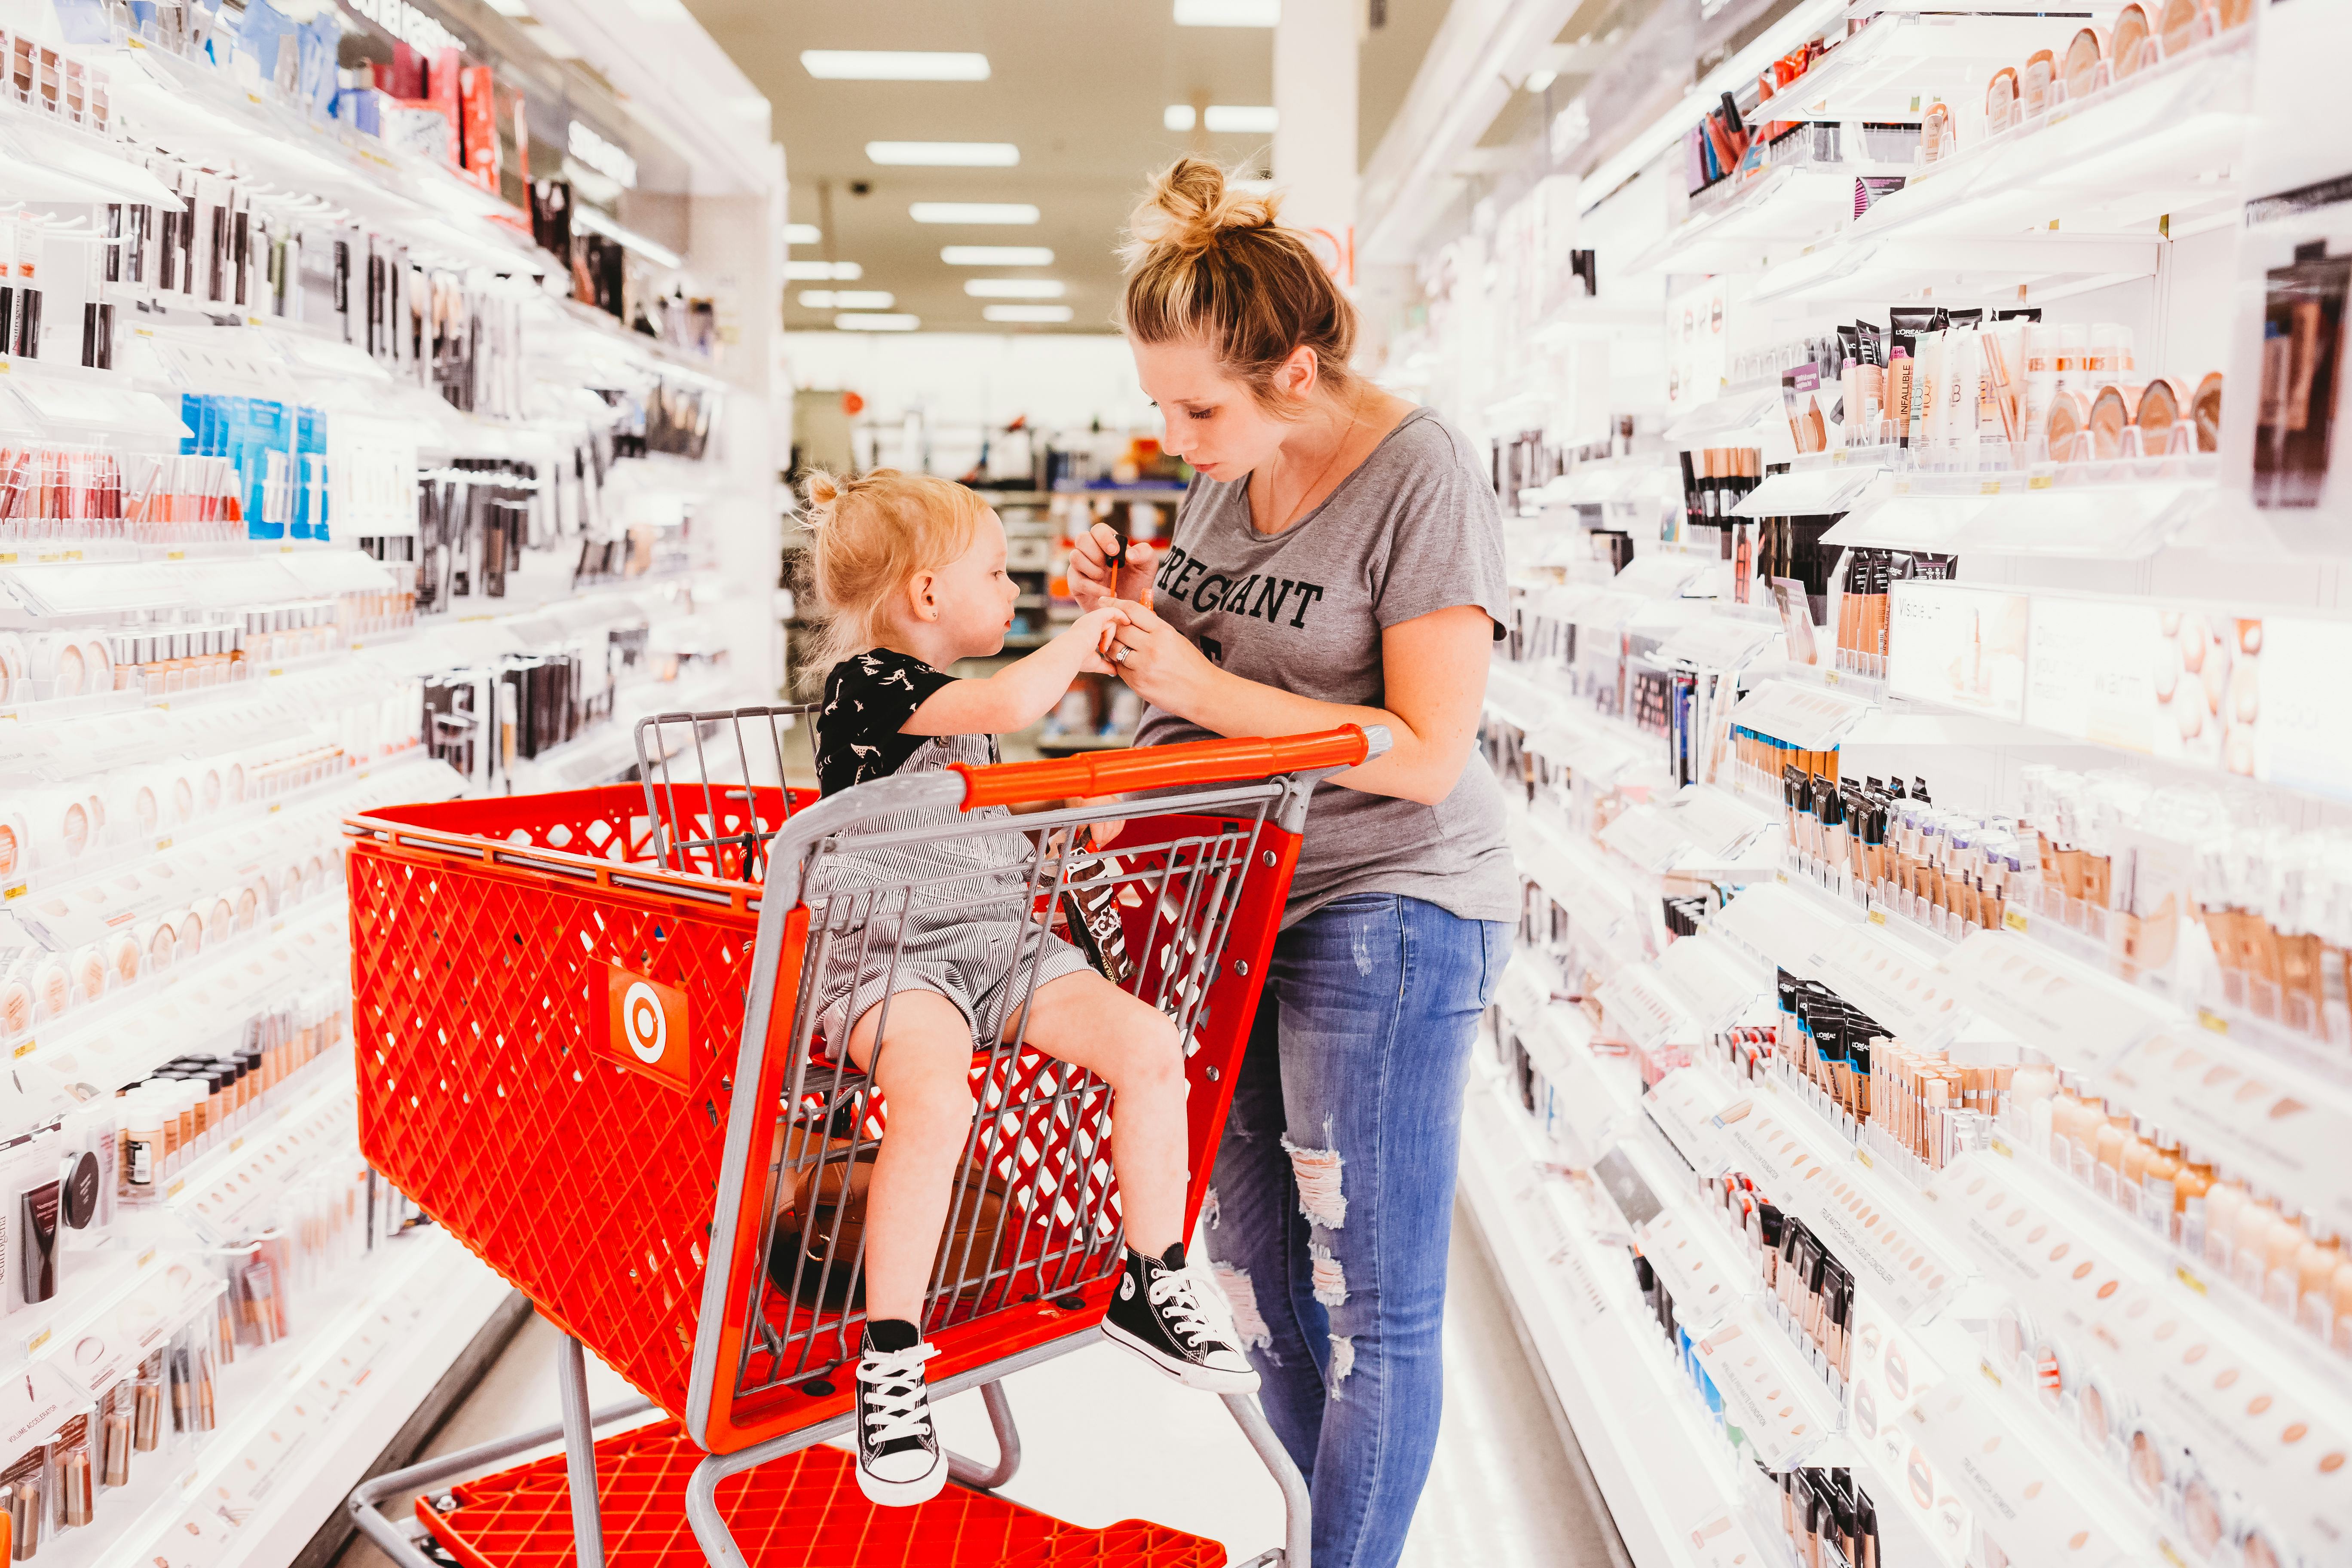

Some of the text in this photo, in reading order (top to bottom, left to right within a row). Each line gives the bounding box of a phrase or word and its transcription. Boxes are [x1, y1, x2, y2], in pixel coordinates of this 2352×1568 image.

[12, 295, 20, 350] Neutrogena
[1900, 364, 1910, 415] INFALLIBLE
[1852, 1041, 1869, 1050] L'ORÉAL
[1761, 1159, 1781, 1179] FOUNDATION
[1818, 1207, 1831, 1220] TRUE
[1827, 1216, 1843, 1231] MATCH
[1868, 1256, 1897, 1285] CONCEALERS
[7, 1404, 58, 1443] VOLUME ACCELERATOR
[1748, 1400, 1769, 1425] FOUNDATION
